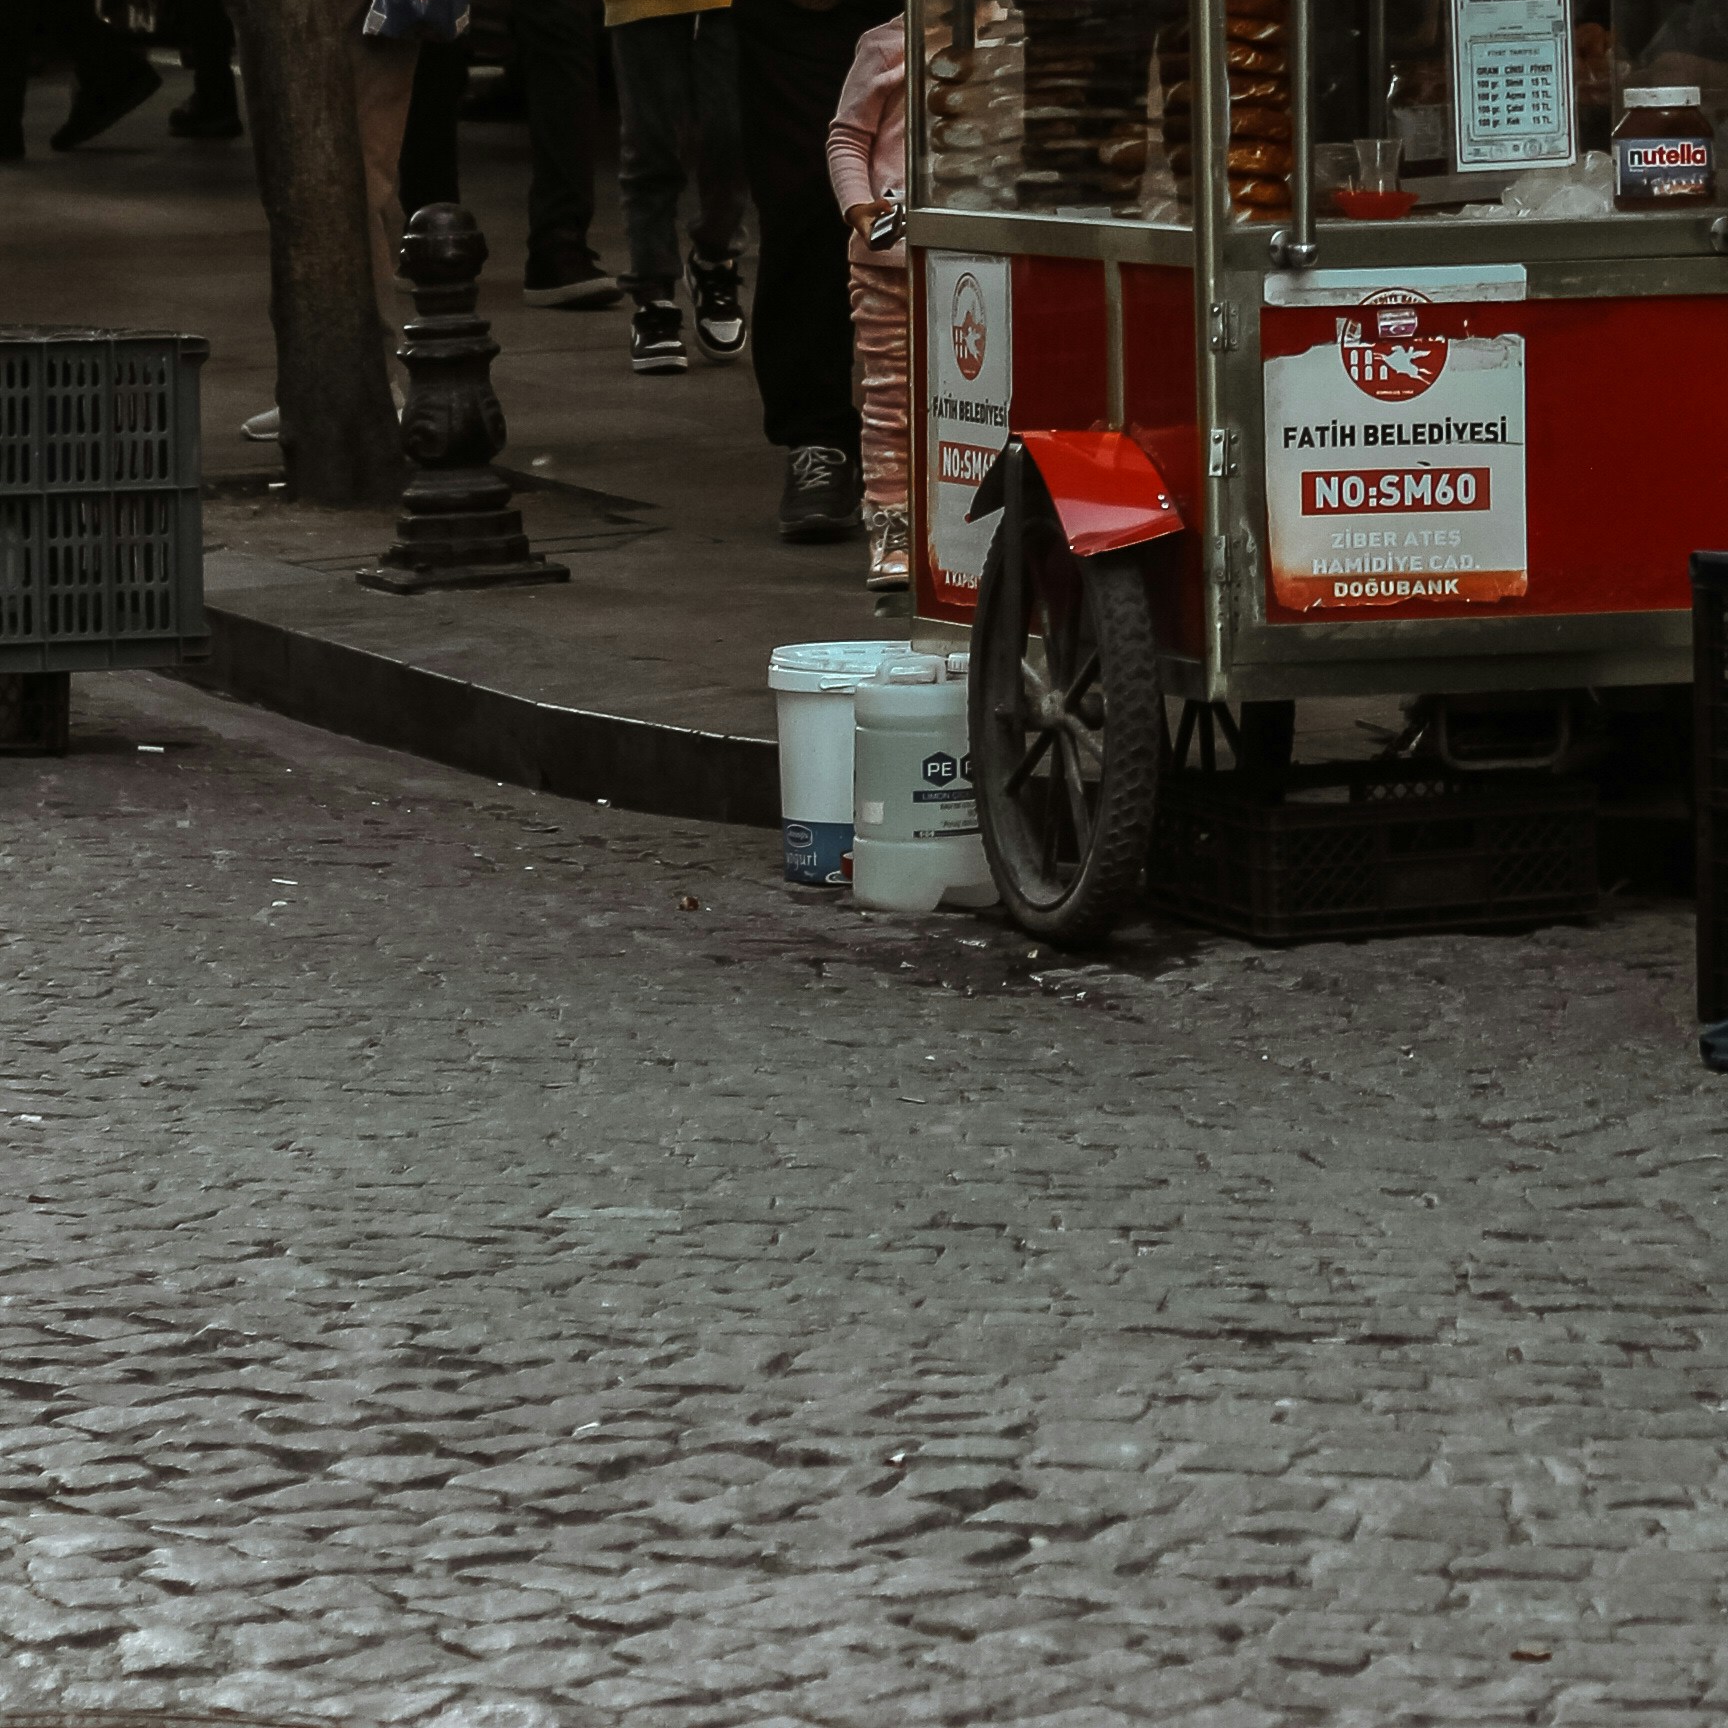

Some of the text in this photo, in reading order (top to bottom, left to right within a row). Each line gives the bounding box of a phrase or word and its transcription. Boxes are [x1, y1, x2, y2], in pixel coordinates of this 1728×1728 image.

[1628, 142, 1707, 167] nutella
[932, 392, 1009, 428] FATİH BELEDİYESİ
[1283, 415, 1508, 449] FATİH BELEDİYESİ
[1315, 473, 1477, 509] NO:SM60
[1331, 529, 1397, 550] ZİBER
[1312, 551, 1481, 576] HAMİDİYE CAD.
[1334, 573, 1460, 598] DOĞUBANK
[927, 762, 953, 777] PE
